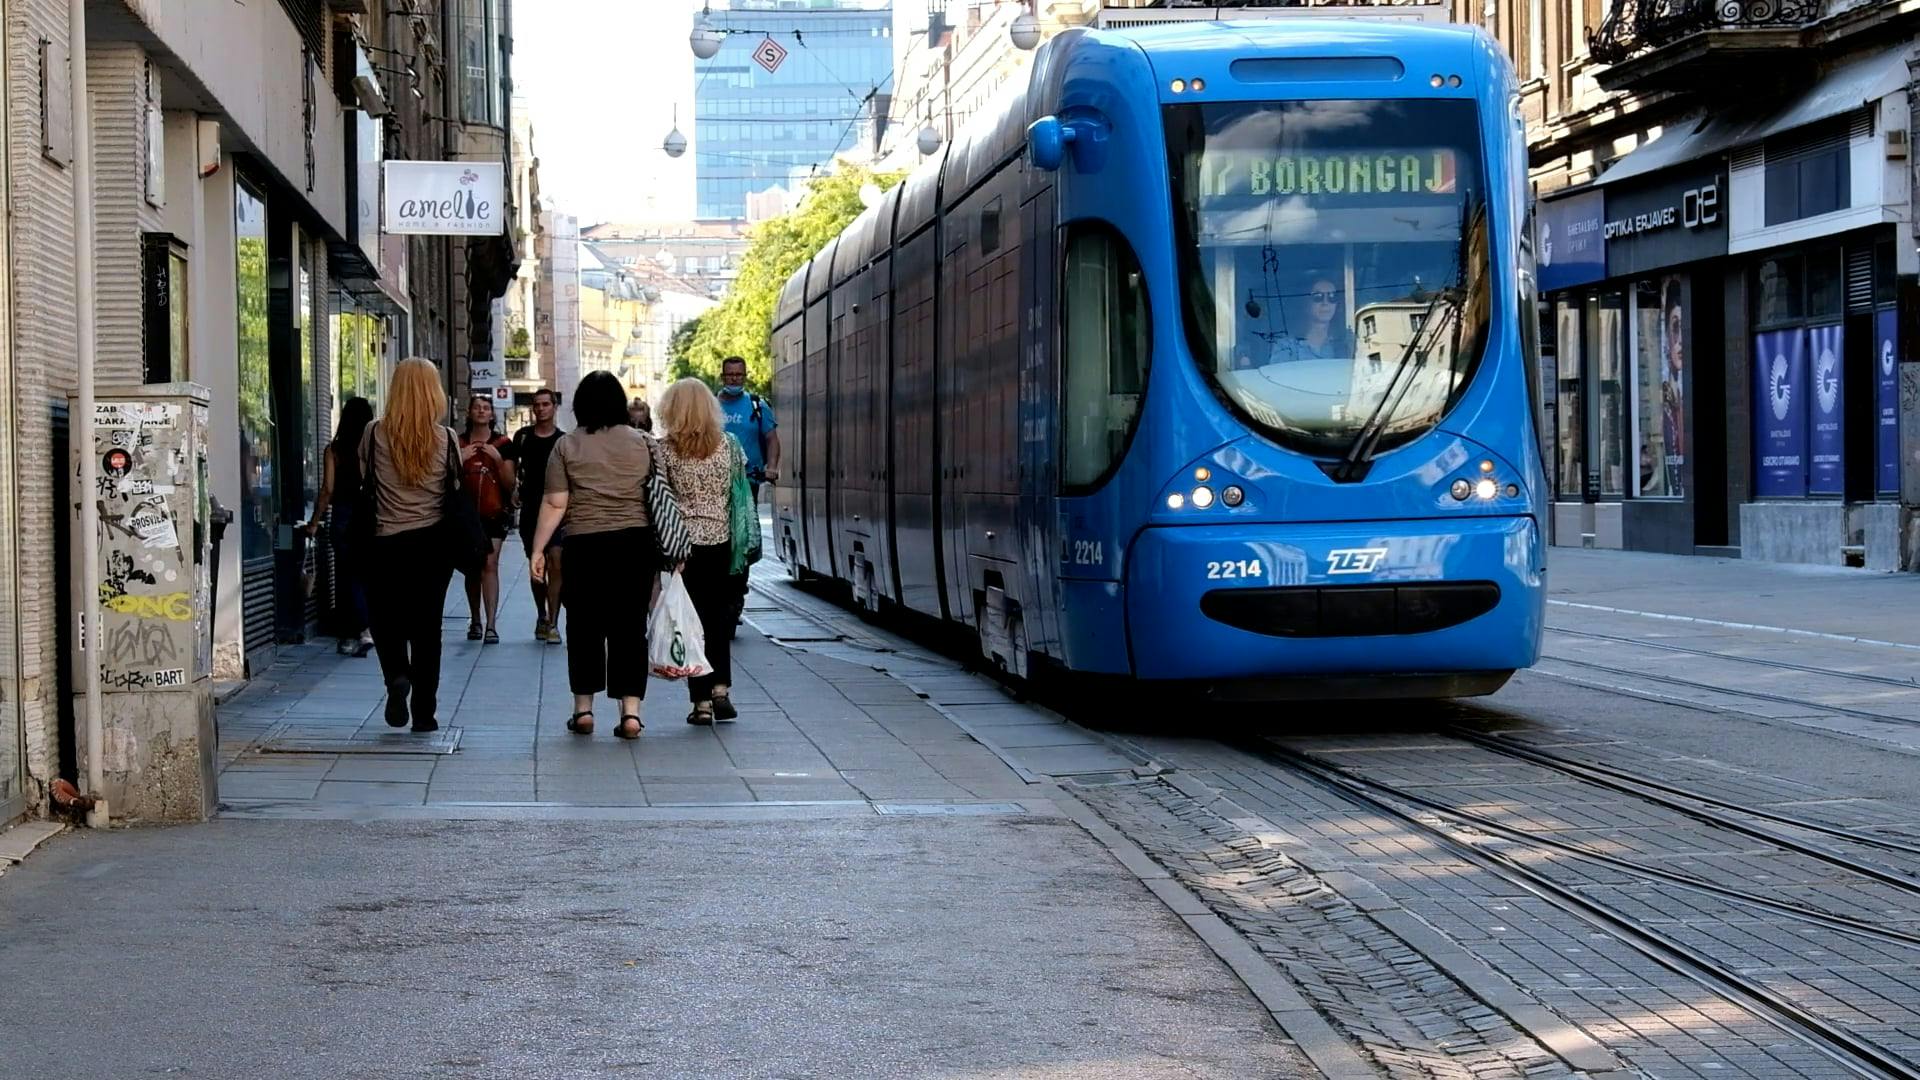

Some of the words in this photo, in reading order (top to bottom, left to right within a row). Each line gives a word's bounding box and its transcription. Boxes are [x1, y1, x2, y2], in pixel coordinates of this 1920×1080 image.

[765, 48, 776, 62] S
[1251, 151, 1443, 195] BORONGAJ
[399, 189, 490, 220] amelie
[1604, 219, 1634, 239] OPTIKA
[1635, 206, 1675, 231] ERJAVEC
[1075, 540, 1103, 565] 2214
[1327, 547, 1388, 574] ZET
[1207, 559, 1262, 579] 2214
[155, 669, 184, 686] BART
